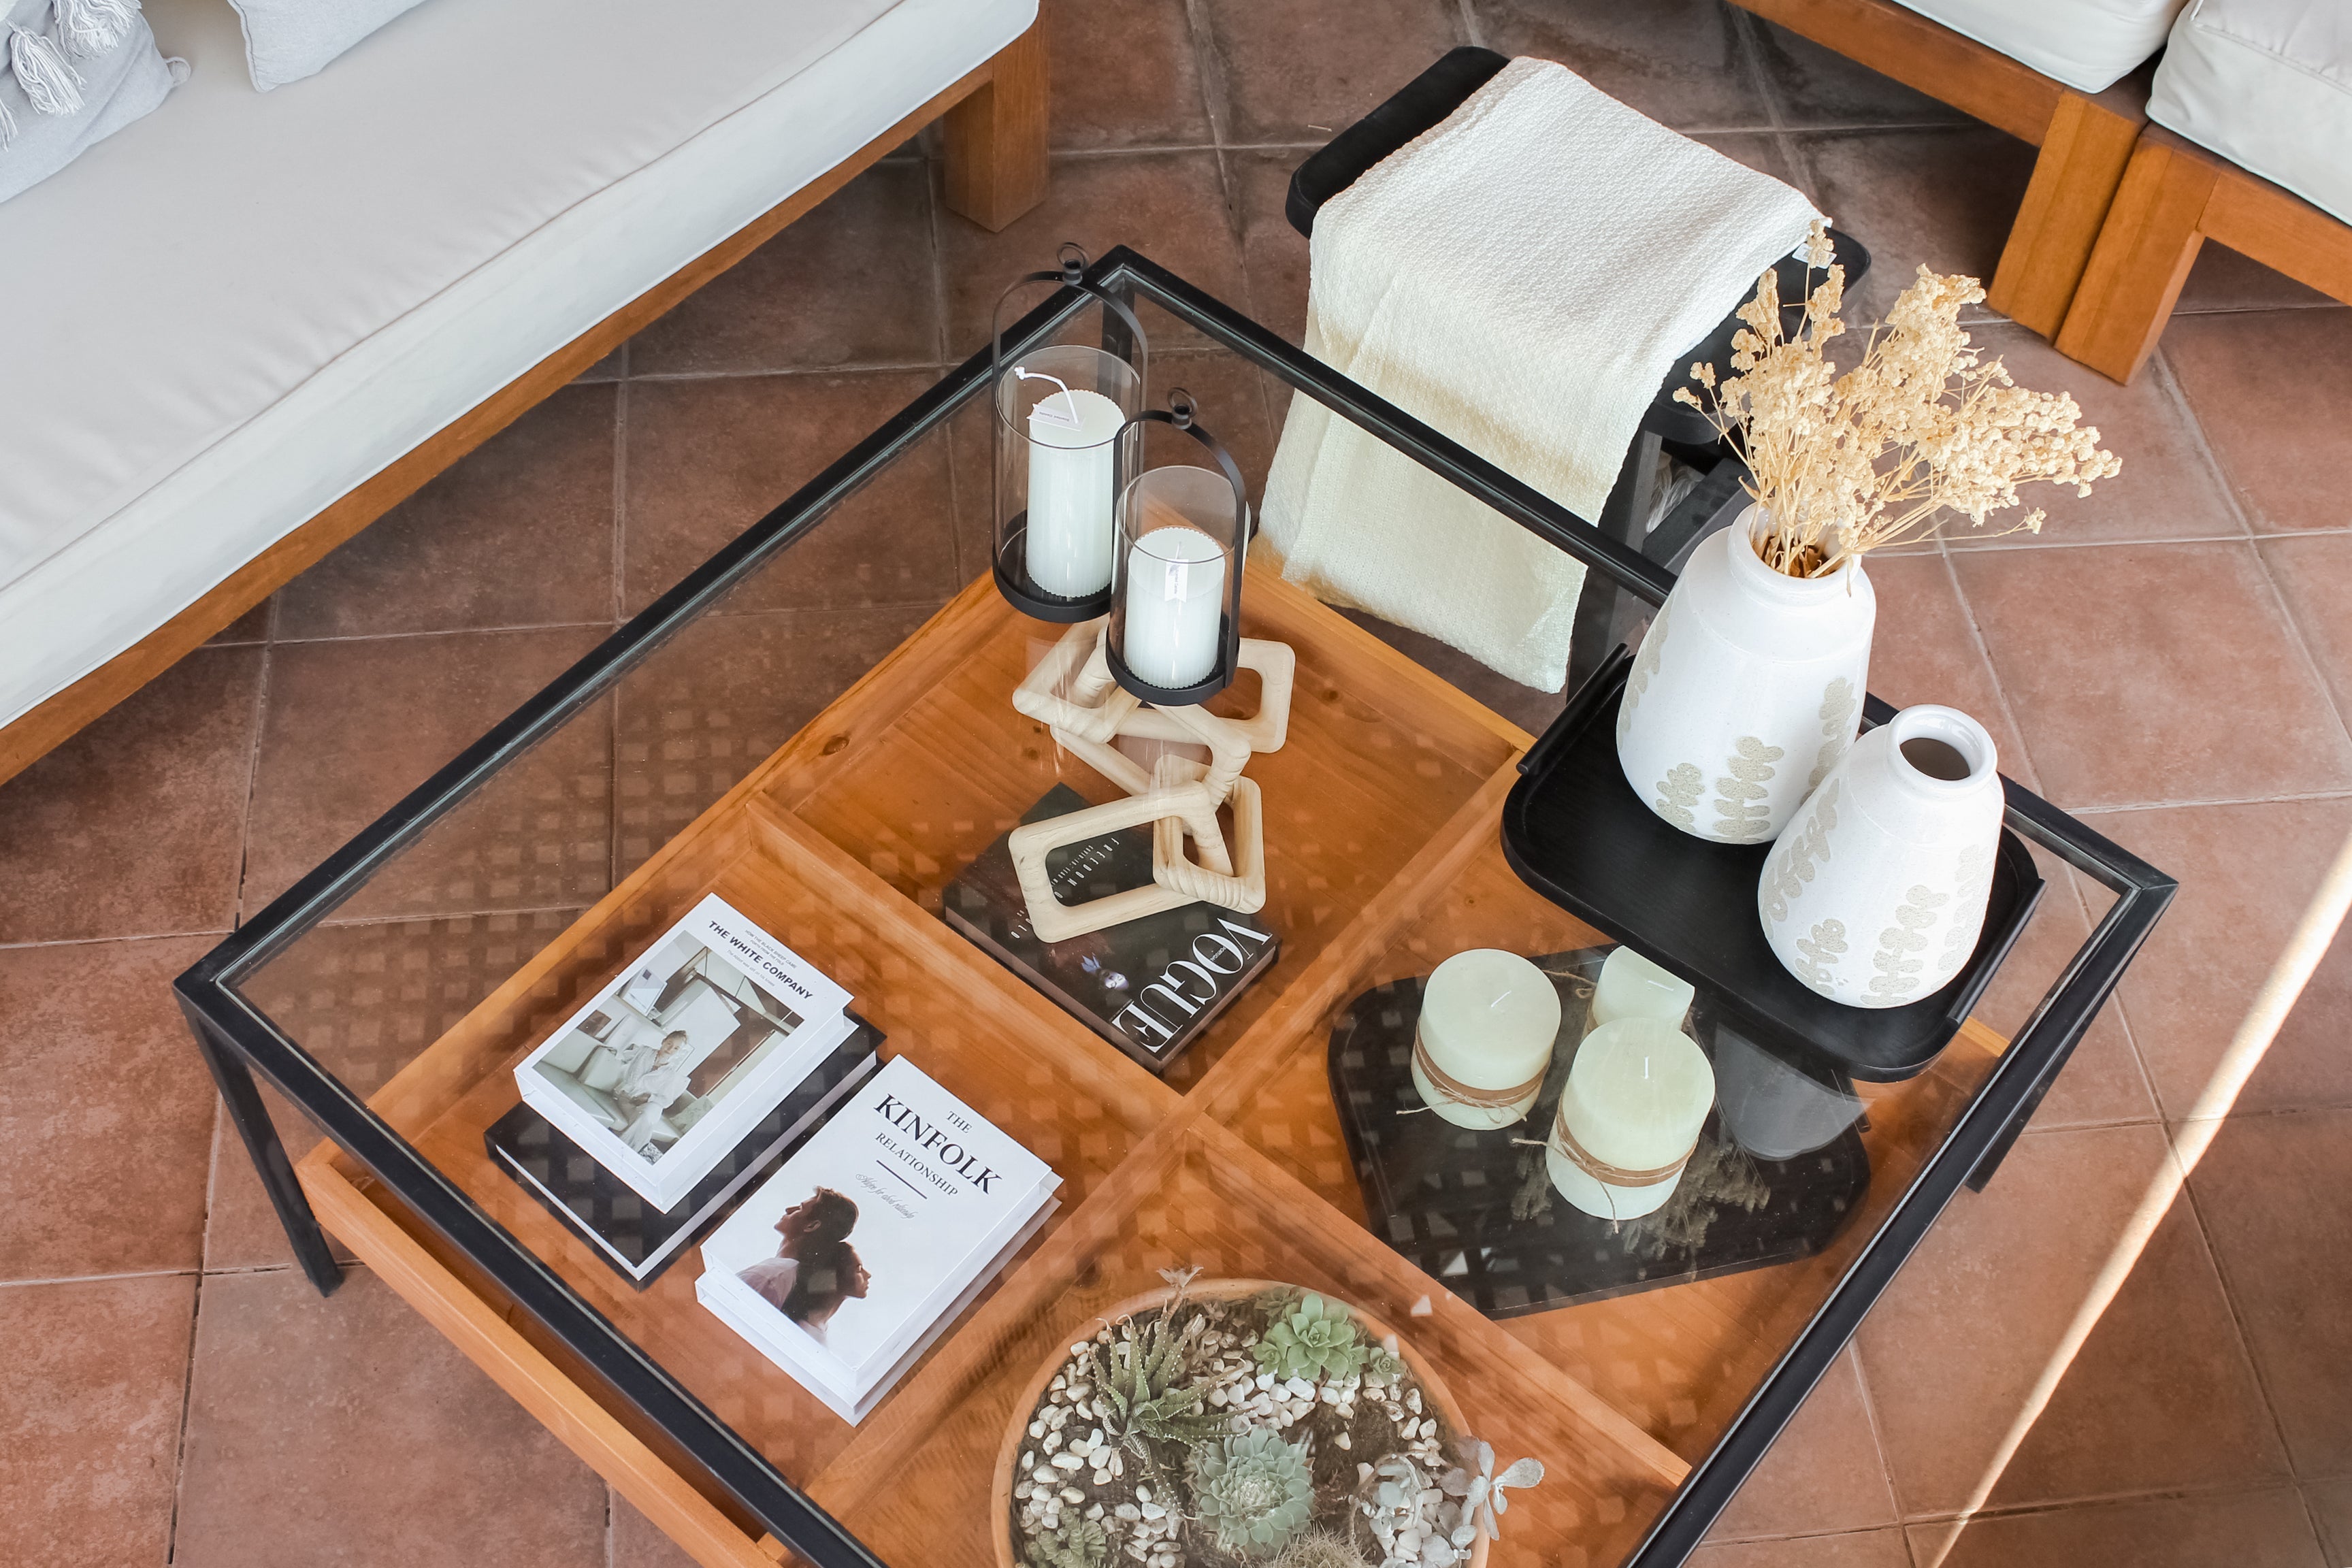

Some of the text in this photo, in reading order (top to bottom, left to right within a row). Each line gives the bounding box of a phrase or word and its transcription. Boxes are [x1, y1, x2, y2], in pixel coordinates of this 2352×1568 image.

[1067, 838, 1119, 886] FREEDOM
[709, 921, 813, 999] THE WHITE COMPANY
[745, 930, 754, 938] HOW
[761, 941, 773, 952] BLACK
[1112, 918, 1273, 1053] VOGUE
[873, 1093, 1002, 1195] KINFOLK
[946, 1111, 973, 1134] THE
[875, 1132, 958, 1196] RELATIONSHIP
